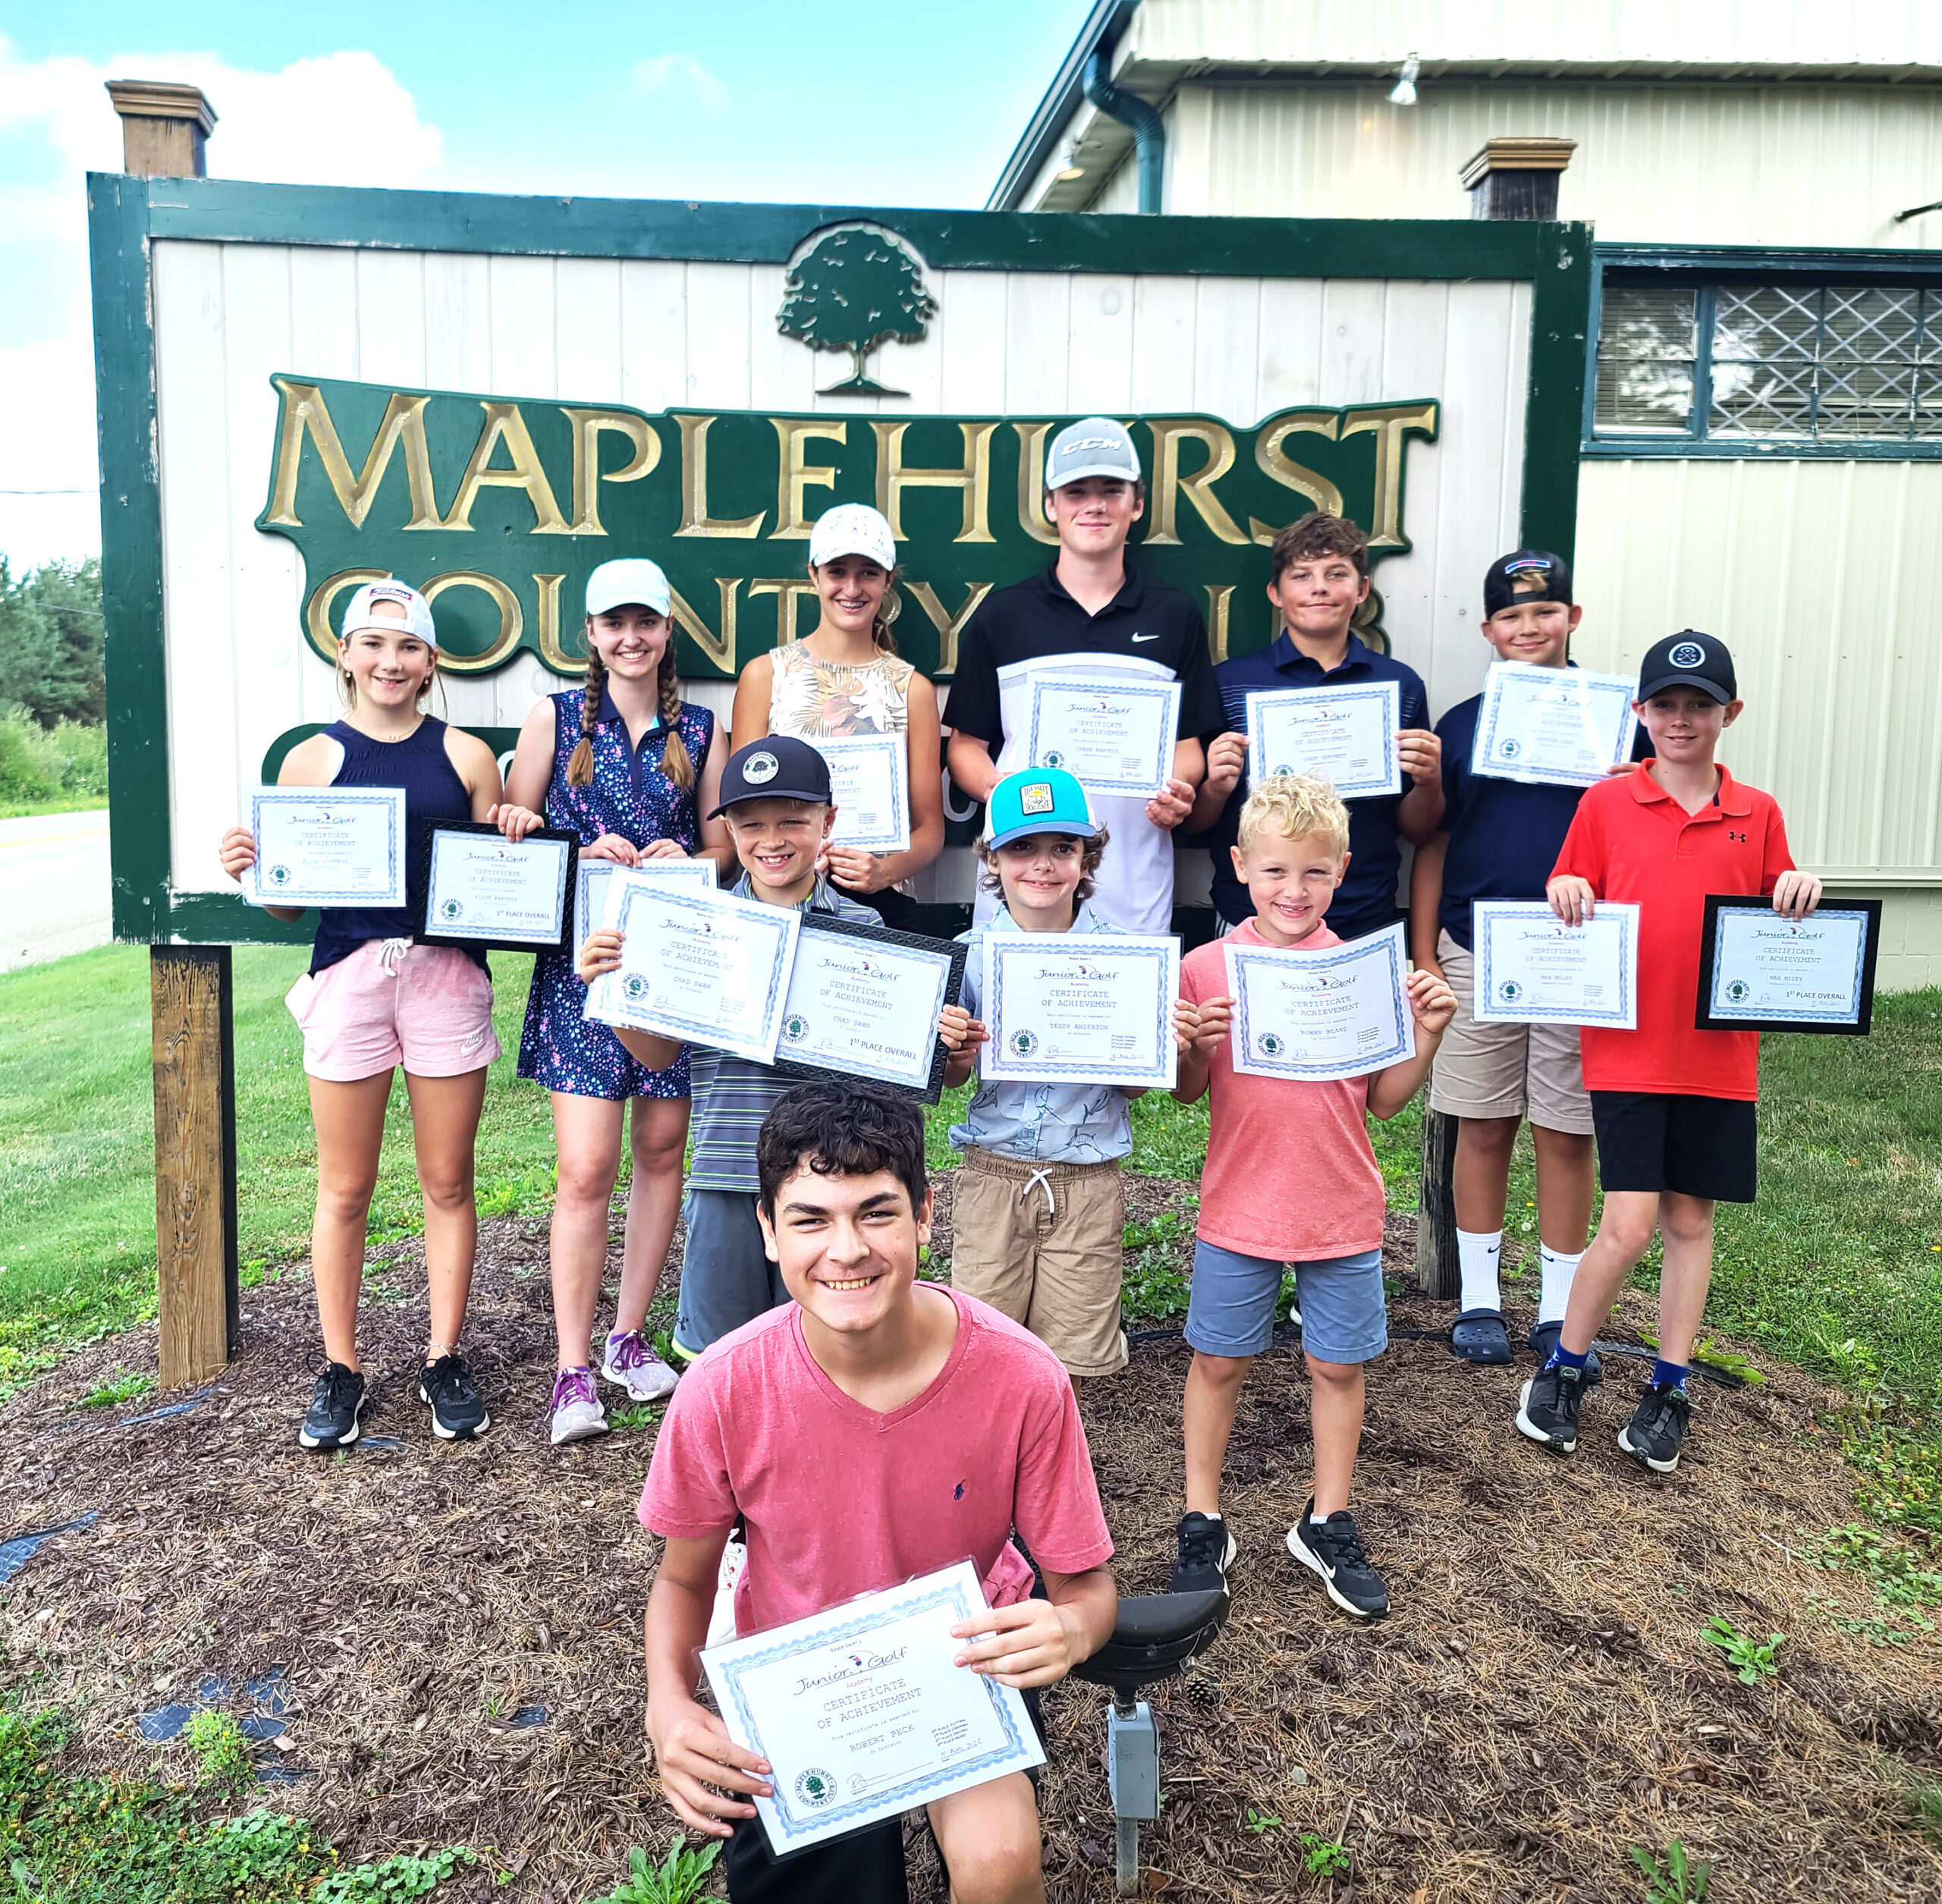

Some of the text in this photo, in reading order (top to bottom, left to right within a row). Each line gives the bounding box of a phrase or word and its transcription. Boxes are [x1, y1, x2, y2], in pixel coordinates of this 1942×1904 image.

[1062, 438, 1123, 456] CCM
[265, 379, 1436, 547] MAPLEHURST
[308, 569, 995, 674] COUNTY
[475, 869, 521, 877] CERTIFICATE
[480, 877, 527, 886] ACHIEVEMENT
[658, 919, 702, 935] Junior
[1751, 930, 1786, 938] Junior
[1517, 932, 1551, 940] Junior
[661, 949, 673, 957] OF
[817, 958, 901, 982] Junior Golf
[1034, 969, 1077, 979] Junior
[1331, 975, 1359, 988] Golf
[830, 980, 888, 999] CERTIFICATE
[1050, 990, 1109, 998] CERTIFICATE
[820, 988, 894, 1010] OF ACHIEVEMENT
[1057, 1000, 1117, 1008] ACHIEVEMENT
[1292, 995, 1352, 1007] CERTIFICATE
[1301, 1002, 1359, 1016] ACHIEVEMENT
[834, 1016, 870, 1029] CHAD SWAN
[861, 1042, 884, 1052] PLACE
[885, 1046, 917, 1060] OVERALL
[793, 1646, 908, 1695] Junior Golf
[823, 1678, 907, 1711] CERTIFICATE
[817, 1687, 922, 1729] OF ACHIEVEMENT
[850, 1724, 915, 1752] ROBERT PECK
